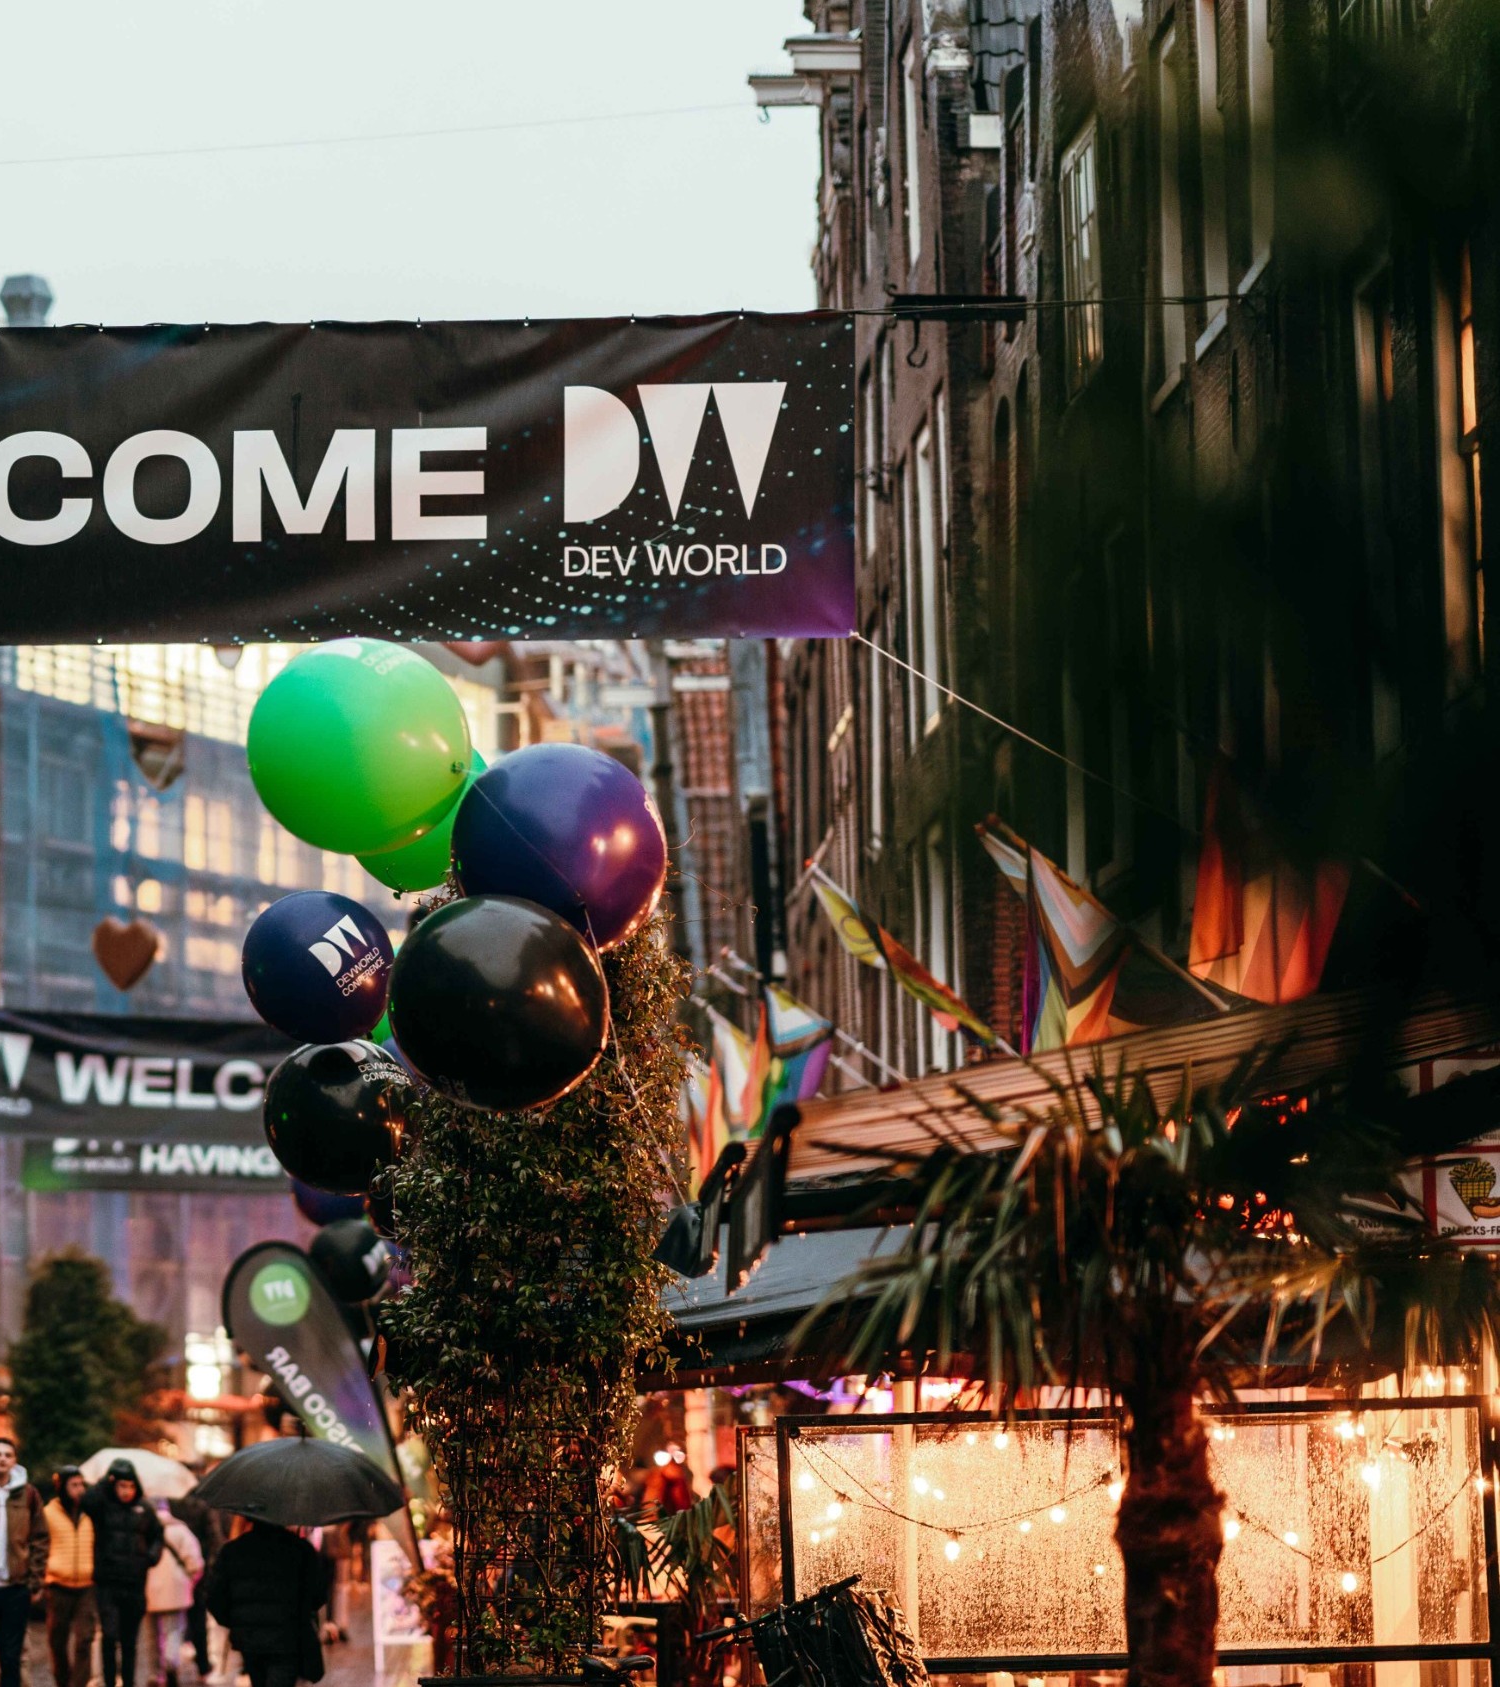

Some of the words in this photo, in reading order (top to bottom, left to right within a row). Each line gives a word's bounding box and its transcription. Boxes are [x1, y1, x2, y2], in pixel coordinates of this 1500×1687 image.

[564, 545, 637, 577] DEV
[646, 543, 787, 576] WORLD
[336, 947, 380, 989] DEVWORLD
[342, 955, 386, 997] CONFERENCE
[55, 1051, 266, 1111] WELC
[140, 1144, 281, 1177] HAVING
